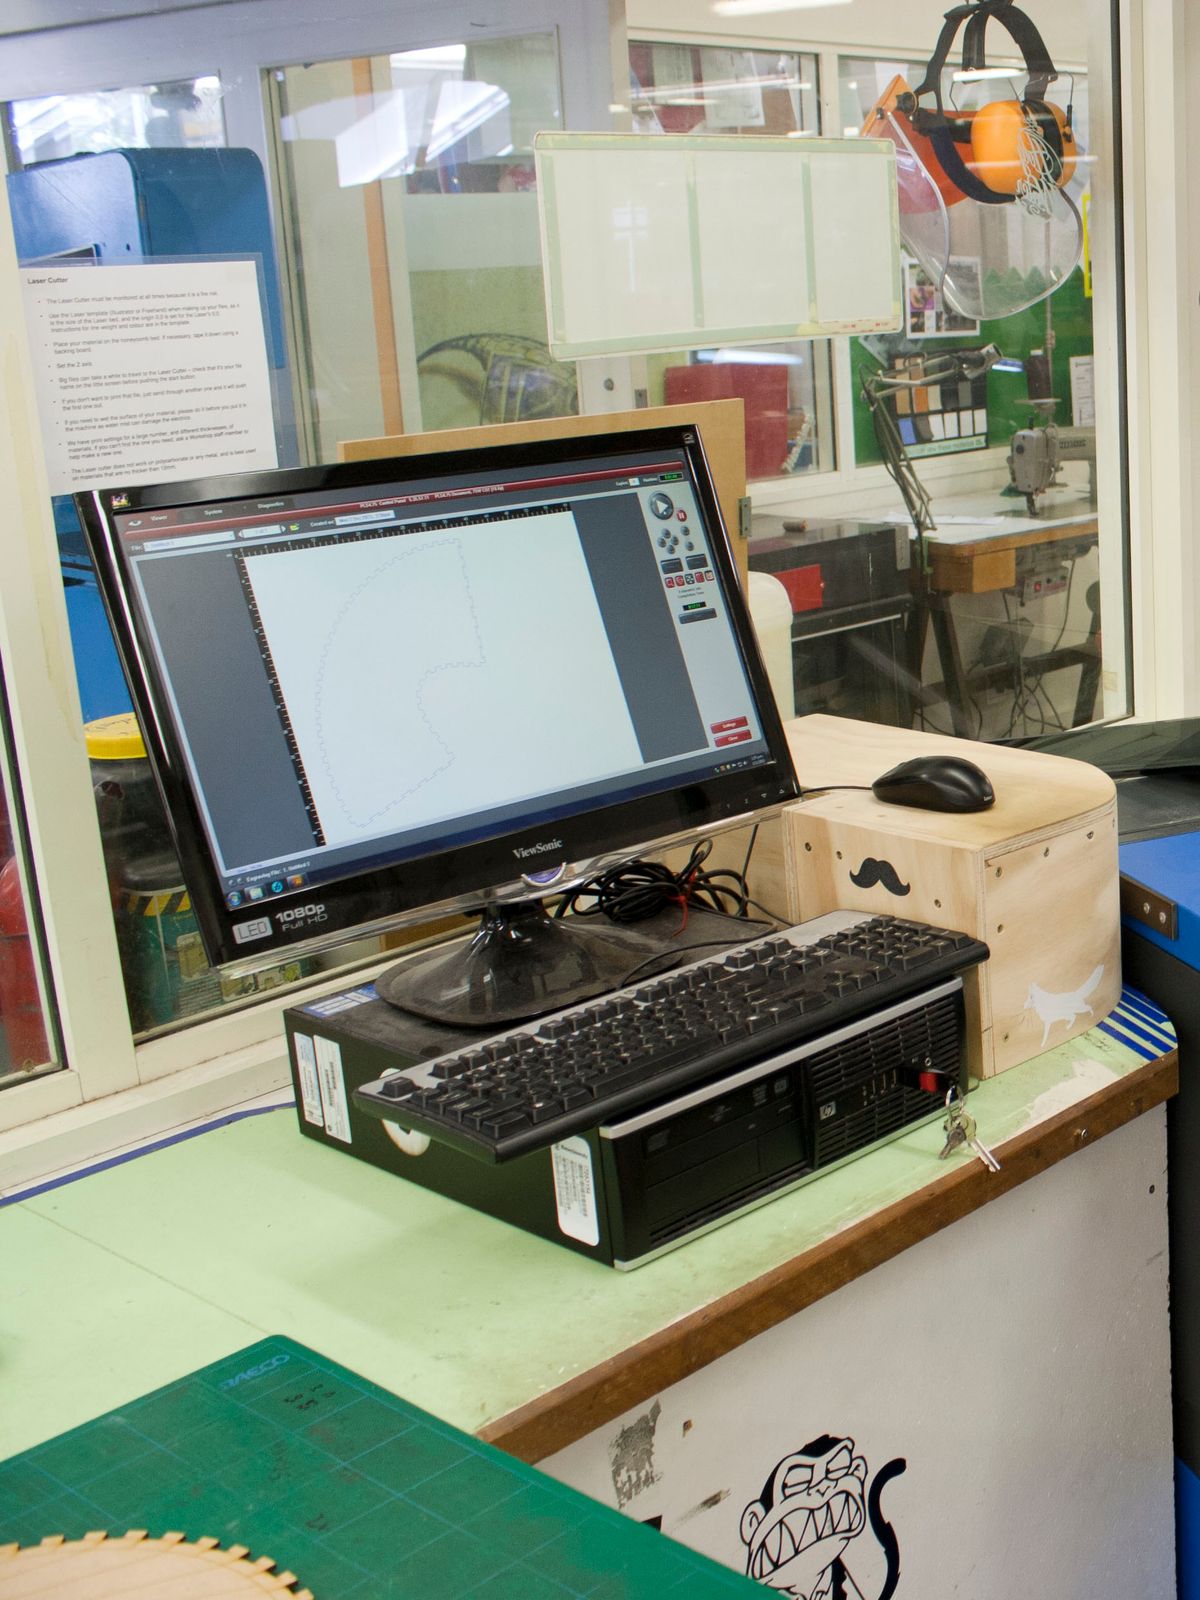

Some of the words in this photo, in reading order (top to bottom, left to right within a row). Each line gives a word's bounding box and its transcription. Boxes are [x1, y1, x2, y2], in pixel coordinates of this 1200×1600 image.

[512, 837, 564, 860] ViewSonic
[276, 904, 326, 924] 1080p
[282, 920, 304, 932] Full
[307, 913, 328, 926] HD
[238, 921, 268, 940] LED
